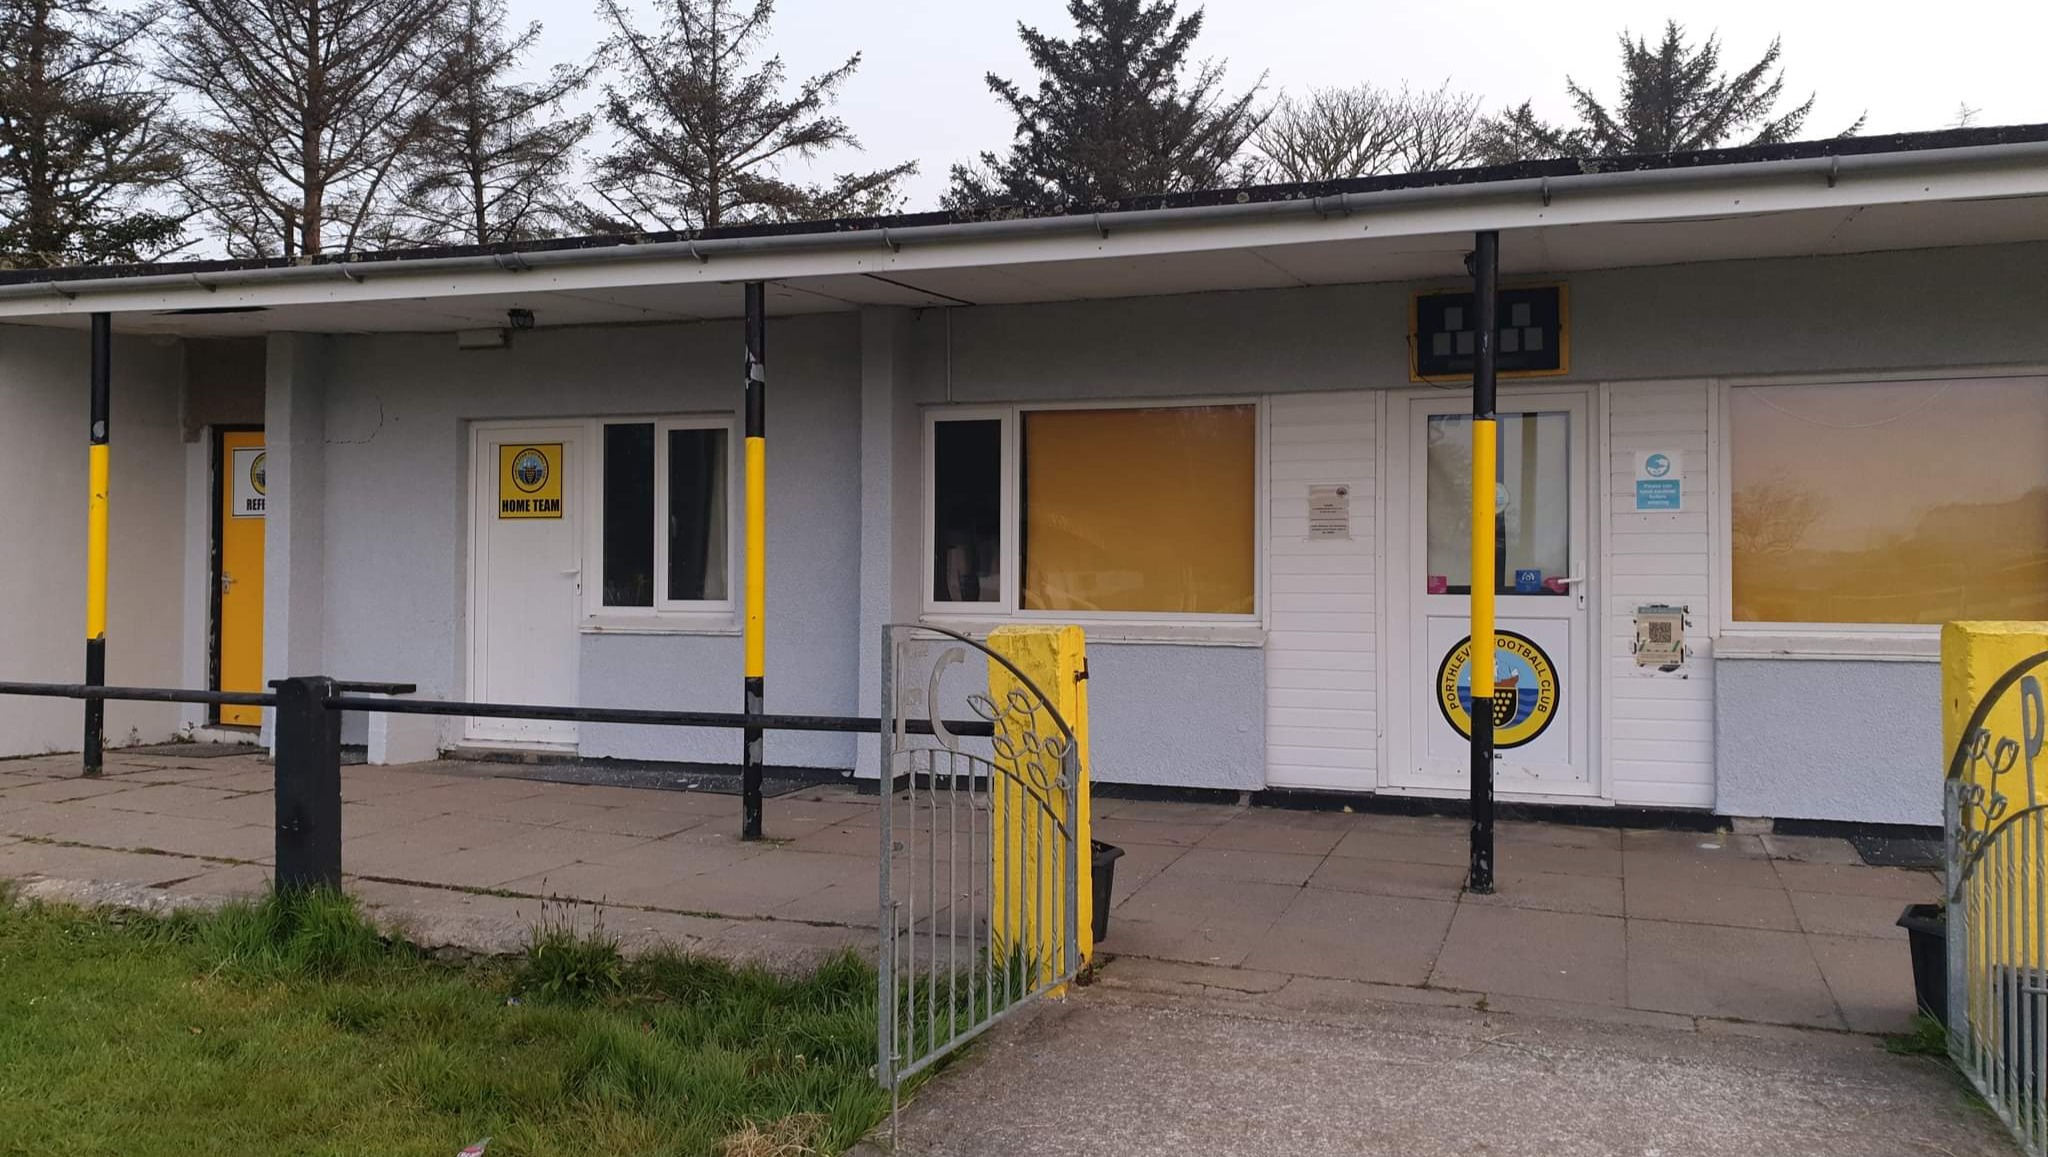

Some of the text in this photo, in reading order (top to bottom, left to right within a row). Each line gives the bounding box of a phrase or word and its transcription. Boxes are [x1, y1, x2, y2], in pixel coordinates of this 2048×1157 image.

[246, 498, 265, 511] REFE
[502, 498, 560, 512] HOME TEAM
[1446, 638, 1552, 713] PORTHLEV OOTBALL CLUB
